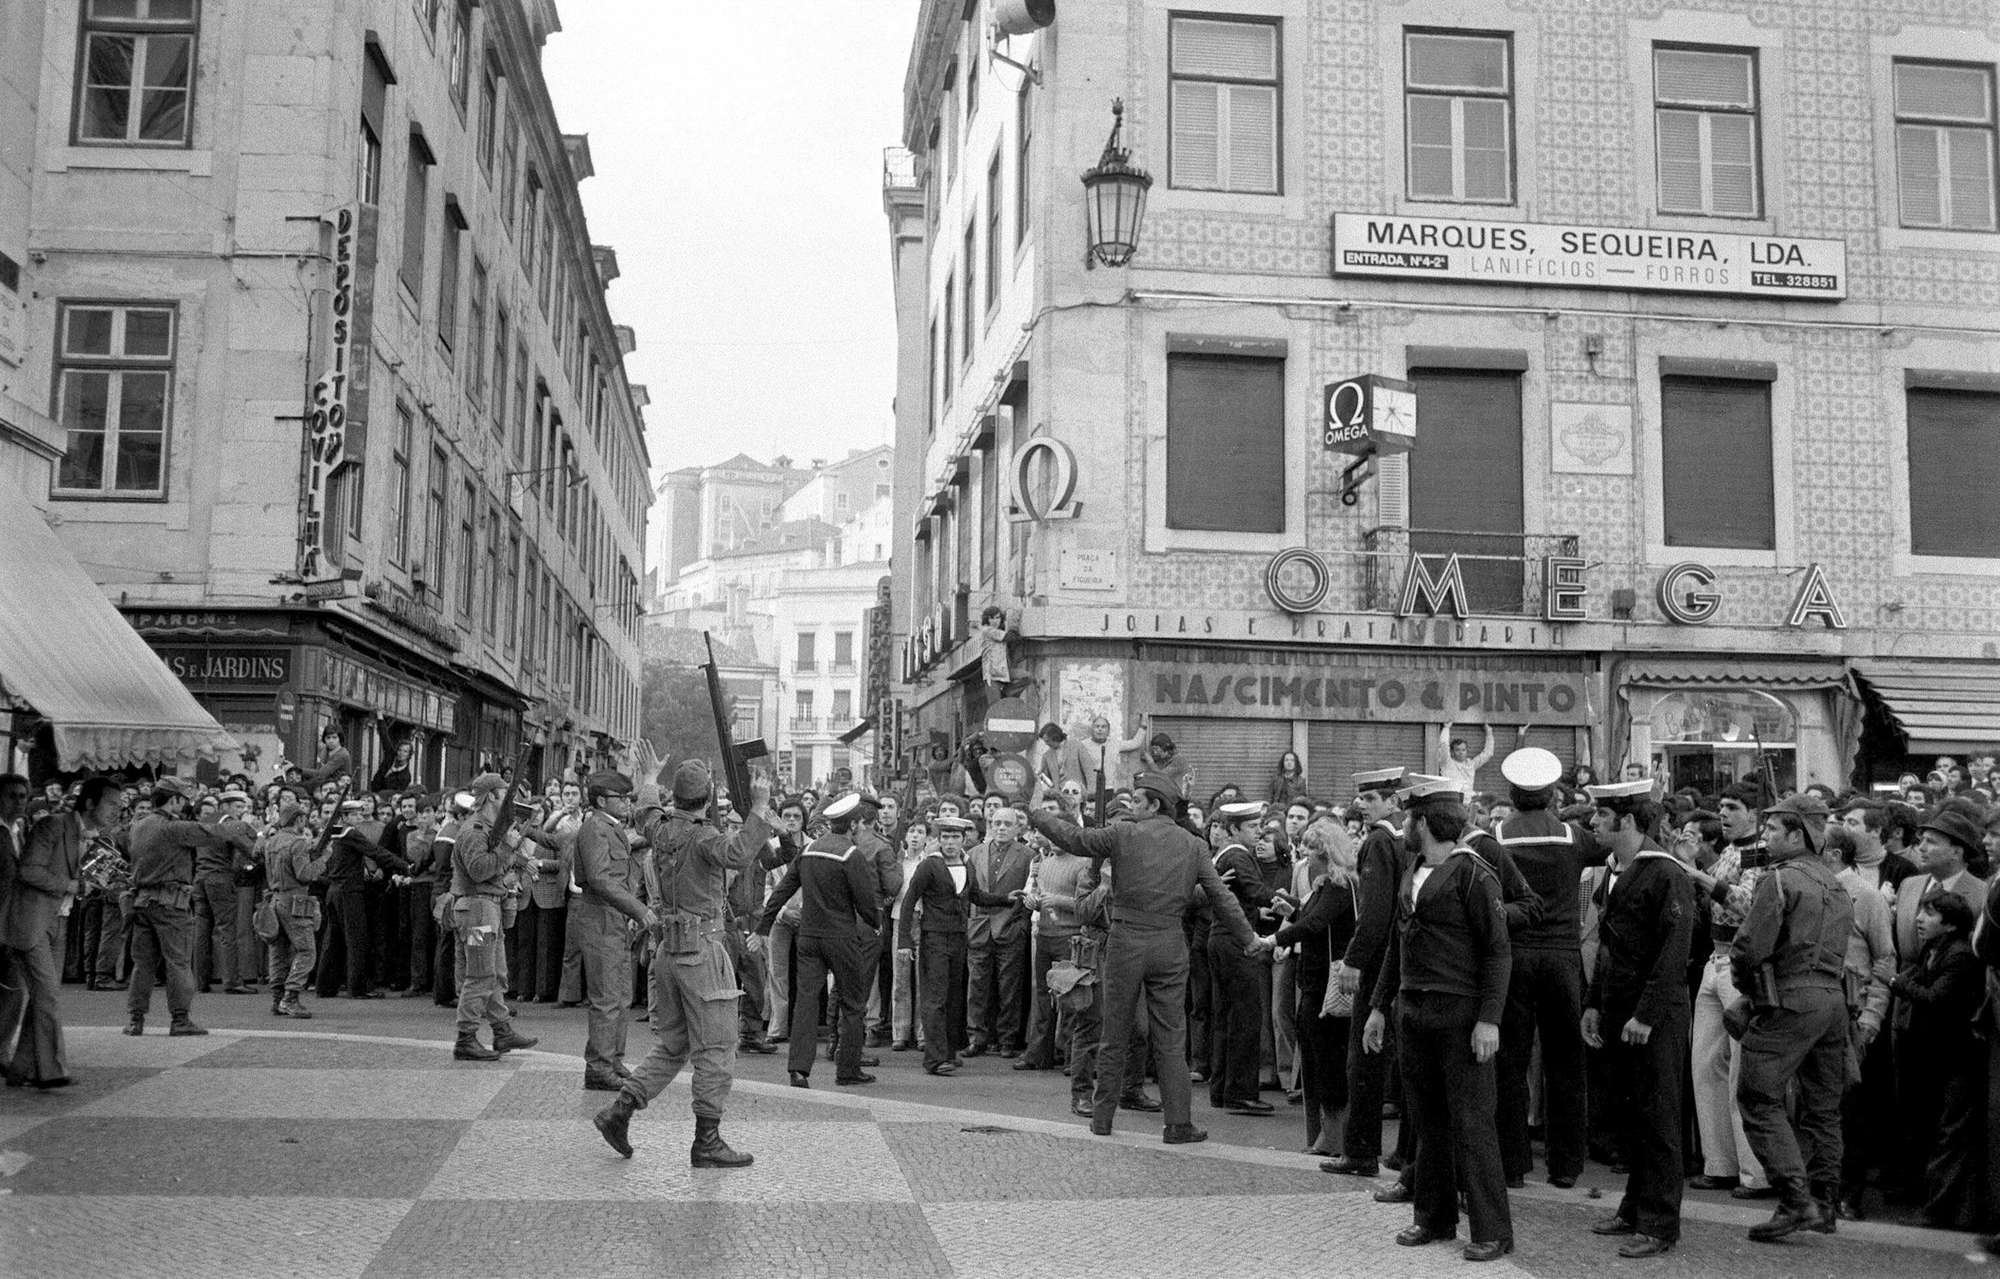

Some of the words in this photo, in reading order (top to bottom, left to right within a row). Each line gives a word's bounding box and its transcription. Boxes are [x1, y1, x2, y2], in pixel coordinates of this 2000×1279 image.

[1368, 221, 1535, 255] MARQUES,
[1561, 231, 1729, 265] SEQUEIRA,
[1750, 241, 1812, 267] LDA.
[1646, 264, 1729, 285] FORROS
[1754, 273, 1784, 286] TEL.
[1786, 275, 1834, 288] 328851
[1325, 424, 1369, 446] OMEGA
[1265, 546, 1847, 630] OMEGA
[1100, 613, 1213, 634] JOIAS
[1248, 616, 1258, 636] E
[1291, 616, 1426, 641] PRATAS
[200, 656, 284, 679] JARDINS
[1155, 673, 1406, 709] NASCIMENTO
[1458, 681, 1576, 713] PINTO
